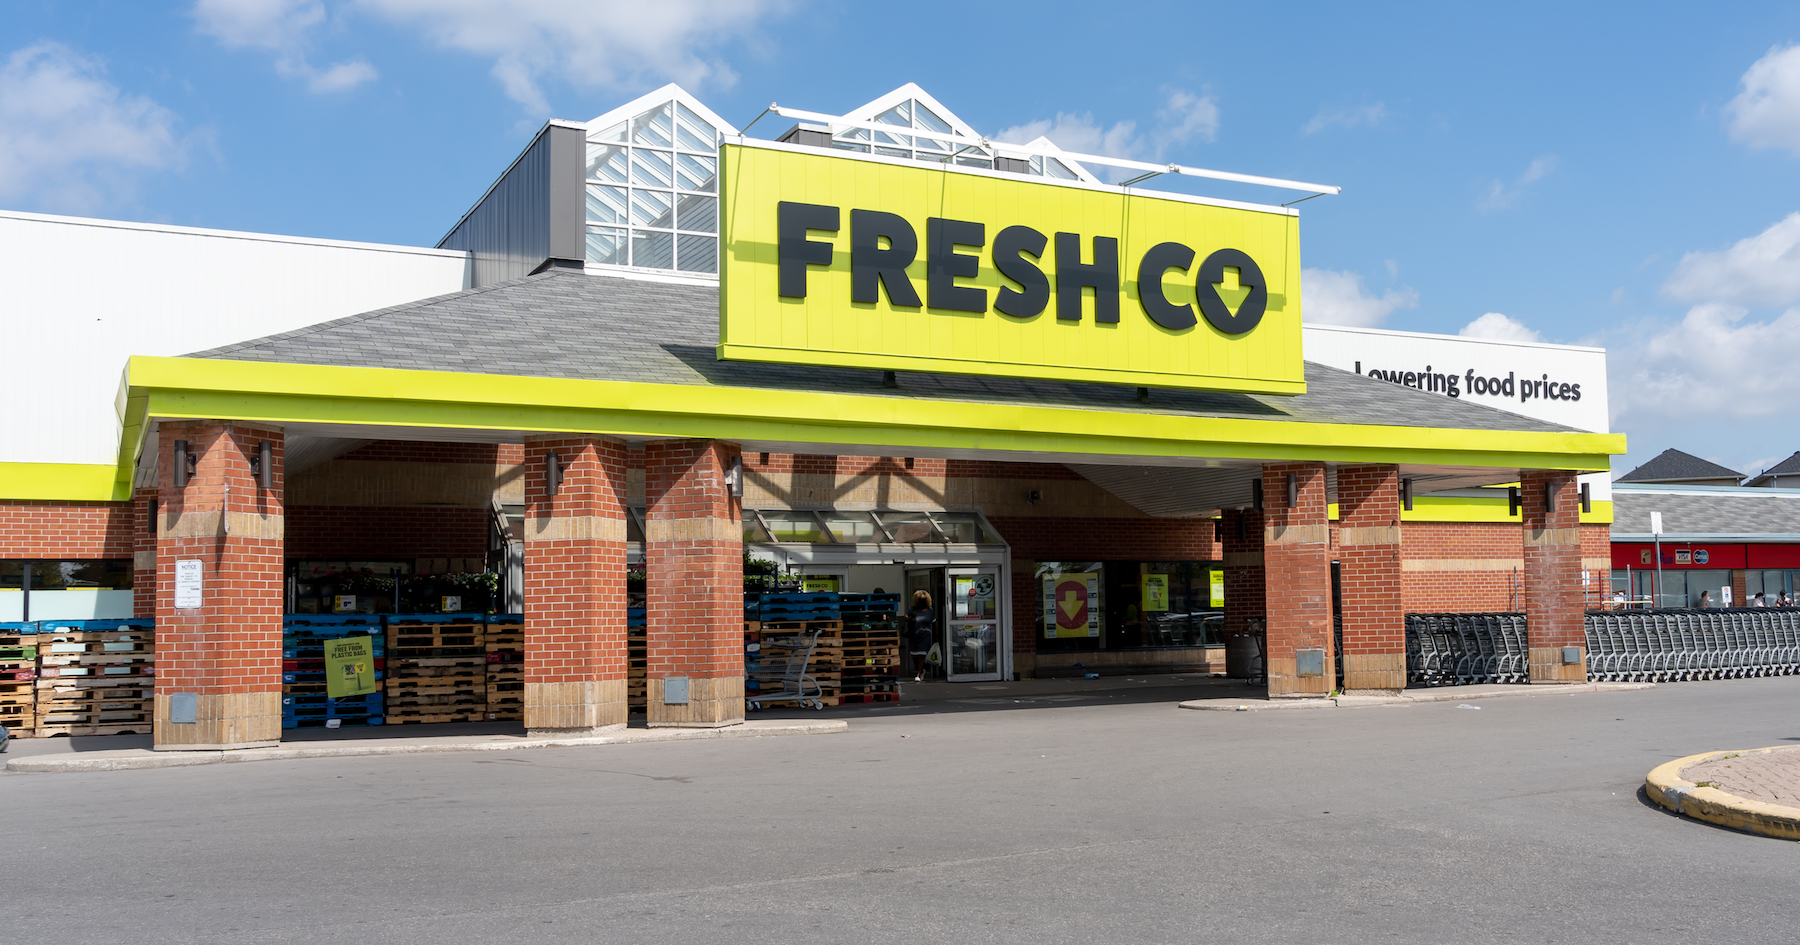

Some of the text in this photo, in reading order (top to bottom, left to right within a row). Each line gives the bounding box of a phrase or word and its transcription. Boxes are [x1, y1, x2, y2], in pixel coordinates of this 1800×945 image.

[777, 200, 1268, 335] FRESH CO
[1464, 368, 1515, 396] food
[1520, 374, 1582, 403] prices
[331, 651, 353, 659] PLASTIC
